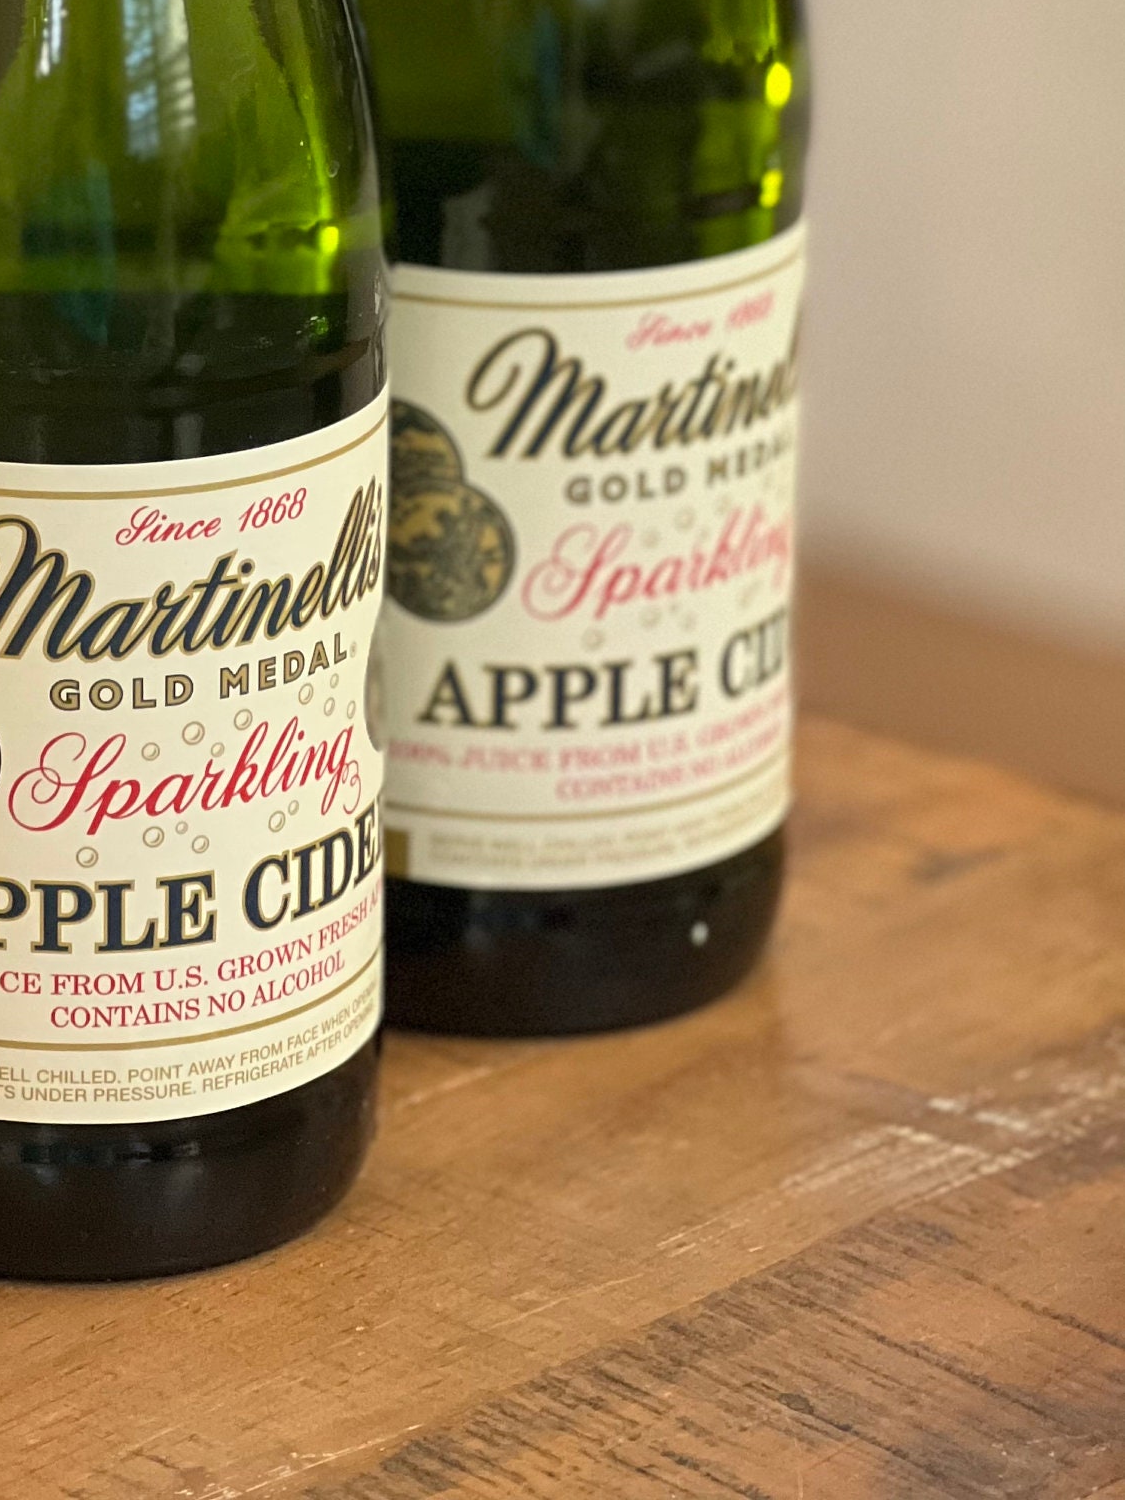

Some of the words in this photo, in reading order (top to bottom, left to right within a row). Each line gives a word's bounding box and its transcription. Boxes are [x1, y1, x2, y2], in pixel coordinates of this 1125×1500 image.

[115, 505, 221, 547] Since
[239, 488, 308, 530] 1868
[565, 466, 686, 505] GOLD
[50, 671, 195, 712] GOLD
[220, 632, 348, 700] MEDAL
[418, 646, 699, 731] APPLE
[8, 718, 362, 837] Sparkling
[241, 794, 382, 931] CIDE
[50, 997, 200, 1029] CONTAINS
[208, 989, 246, 1018] NO
[251, 949, 346, 1008] ALCOHOL
[51, 971, 146, 996] FROM
[154, 964, 209, 992] U.S.
[217, 933, 312, 982] GROWN
[318, 903, 369, 951] FRESH
[21, 1085, 87, 1102] UNDER
[93, 1082, 196, 1102] PRESSURE.
[202, 1052, 304, 1093] REFRIGERATE
[306, 1034, 342, 1061] AFTER
[36, 1068, 121, 1085] CHILLED.
[128, 1064, 183, 1083] POINT
[187, 1054, 236, 1077] AWAY
[240, 1041, 283, 1066] FROM
[286, 1024, 319, 1051] FACE
[321, 1007, 351, 1034] WHEN
